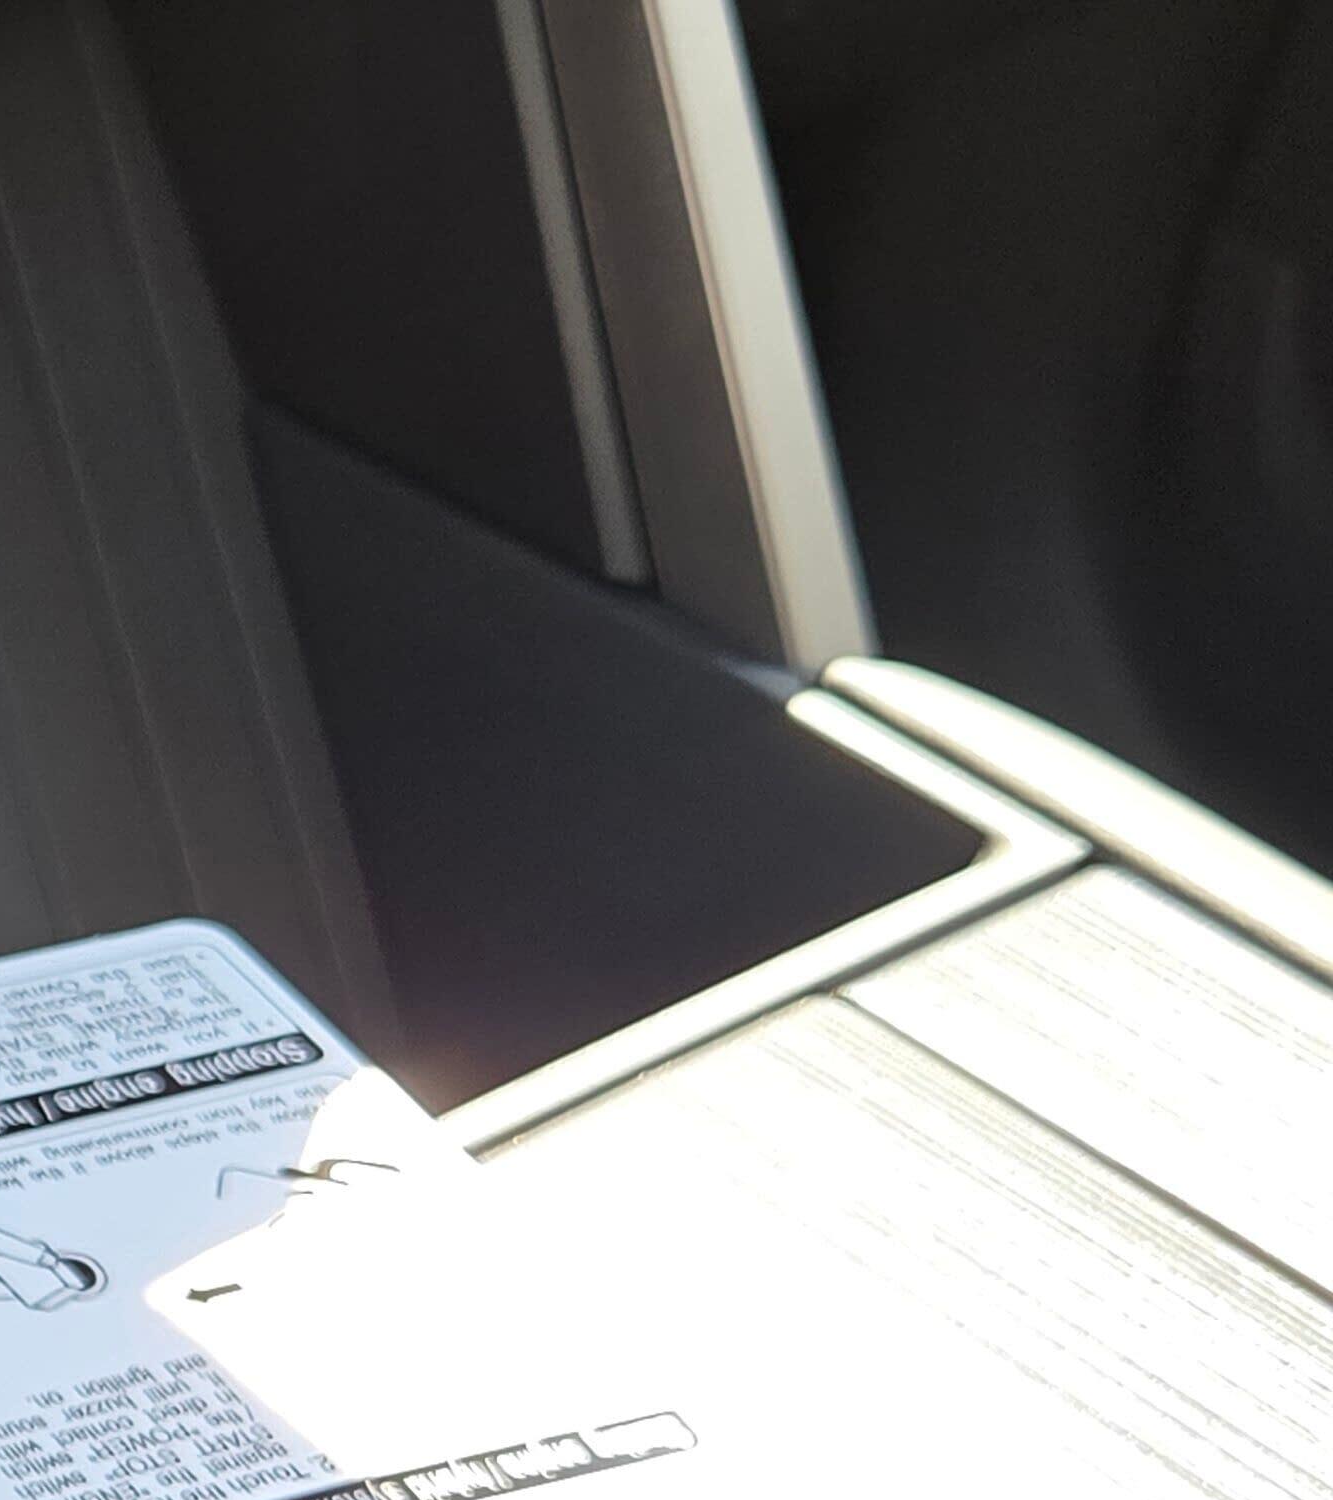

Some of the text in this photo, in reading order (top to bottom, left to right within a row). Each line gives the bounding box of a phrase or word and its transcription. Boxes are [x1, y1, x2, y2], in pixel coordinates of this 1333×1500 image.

[167, 1039, 307, 1084] Stopping
[163, 1355, 206, 1377] and
[143, 1378, 190, 1403] until
[214, 1387, 242, 1404] in
[62, 1394, 137, 1421] buzzer
[143, 1397, 207, 1424] direct
[52, 1415, 133, 1447] contact
[203, 1442, 287, 1476] against
[14, 1471, 86, 1500] switch
[156, 1467, 198, 1486] the
[226, 1463, 310, 1493] Touch
